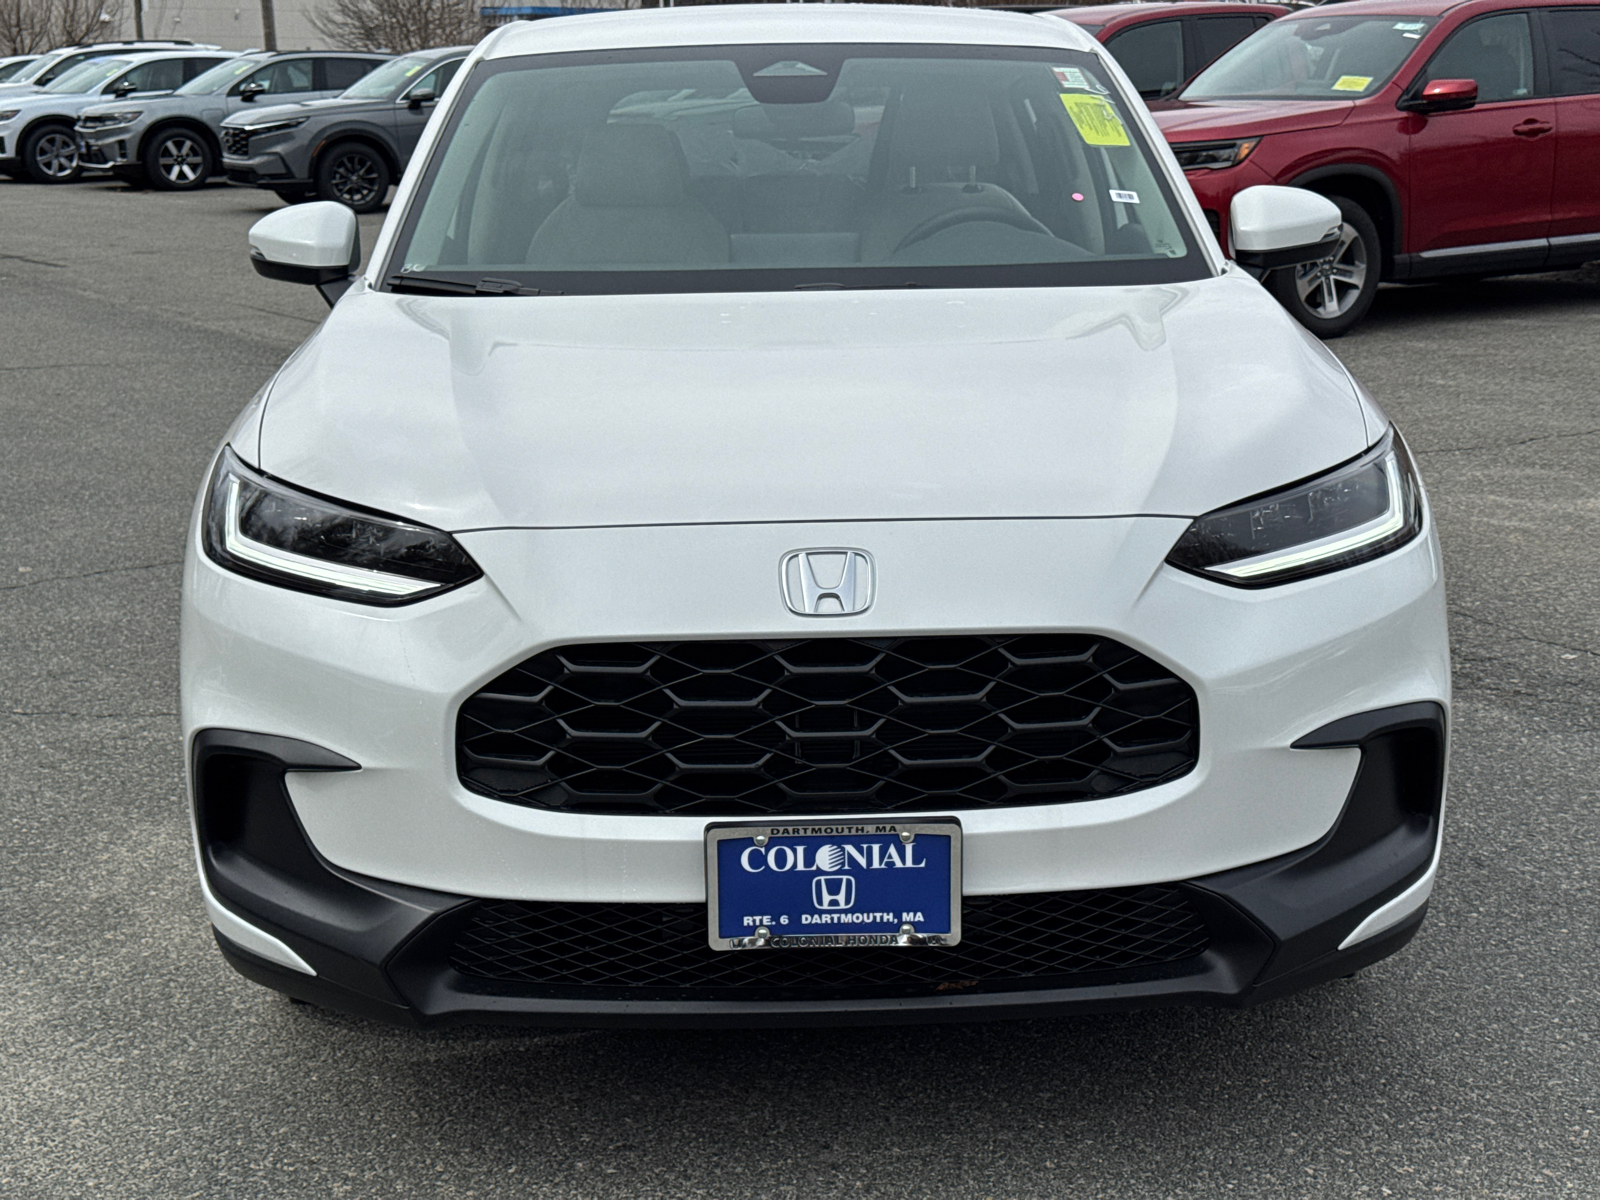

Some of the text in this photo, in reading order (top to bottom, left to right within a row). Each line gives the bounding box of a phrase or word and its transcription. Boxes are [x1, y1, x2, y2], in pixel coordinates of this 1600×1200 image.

[770, 825, 898, 836] DARTMOUTH, MA
[740, 842, 927, 873] COLONIAL
[743, 911, 925, 926] RTE. 6 DARTMOUTH, MA
[770, 933, 899, 948] COLONIAL HONDA
